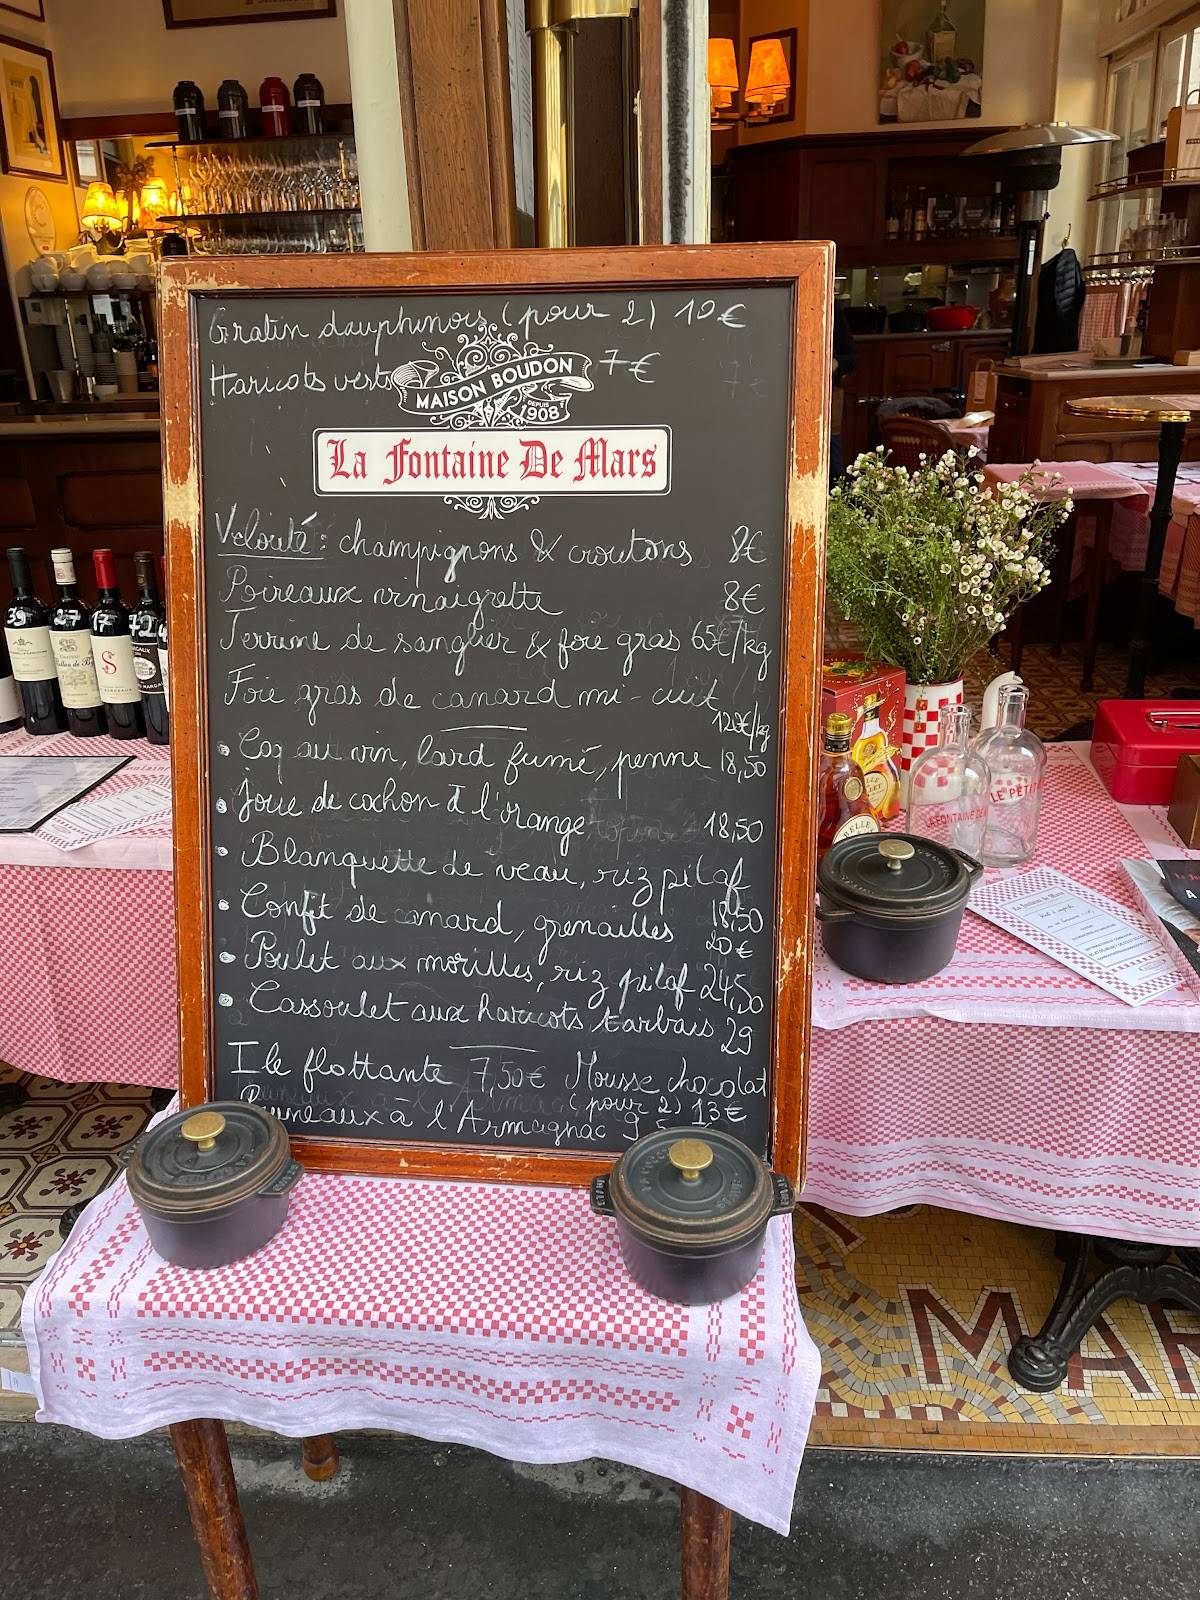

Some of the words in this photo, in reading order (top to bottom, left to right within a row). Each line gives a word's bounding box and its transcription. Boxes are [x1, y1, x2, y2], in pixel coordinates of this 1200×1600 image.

[209, 307, 309, 344] Gratin
[318, 306, 487, 356] dauphinois
[502, 301, 610, 340] (pour
[674, 299, 746, 328] 10€
[209, 361, 326, 398] Haricots
[334, 362, 394, 392] verts
[599, 349, 660, 383] 7€
[416, 380, 487, 409] MAISON
[490, 357, 573, 389] BOUDON
[521, 405, 559, 422] 1908
[527, 400, 550, 409] DEPUIS
[326, 438, 368, 480] La
[383, 437, 509, 486] Fontaine
[519, 439, 563, 481] De
[572, 437, 657, 484] Mars
[339, 518, 518, 588] champignons
[530, 528, 562, 562] &
[729, 525, 767, 563] 8€
[7, 606, 27, 627] 39
[54, 608, 81, 627] 27
[91, 610, 113, 634] 17
[220, 565, 362, 603] Poireaux
[374, 577, 563, 630] vinaigrette
[722, 580, 765, 614] 8€
[102, 650, 117, 675] S
[220, 607, 330, 650] Terrine
[340, 622, 386, 653] de
[394, 620, 518, 676] sanglier
[525, 631, 550, 659] &
[558, 628, 608, 670] foie
[616, 629, 681, 676] gras
[224, 663, 285, 705] Foie
[295, 684, 362, 726] gras
[374, 677, 421, 709] de
[432, 679, 572, 710] canard
[239, 726, 283, 784] Coq
[296, 740, 342, 760] au
[417, 735, 495, 767] lard
[611, 750, 712, 799] penne
[721, 748, 767, 783] 18,50
[311, 780, 342, 813] de
[349, 777, 440, 813] cochon
[703, 810, 764, 844] 18,50
[844, 820, 872, 838] BELLE
[241, 830, 436, 889] Blanquette
[442, 850, 483, 876] de
[592, 861, 653, 907] riz
[660, 855, 752, 916] pilaf
[712, 899, 764, 933] 18,50
[239, 882, 334, 936] Confit
[344, 895, 387, 923] de
[534, 905, 675, 966] grenailles
[244, 930, 340, 972] Poulet
[351, 954, 407, 971] aux
[550, 960, 609, 1009] riz
[619, 962, 696, 1014] pilaf
[700, 962, 764, 1015] 24,50
[249, 979, 409, 1022] Cassoulet
[411, 1002, 469, 1023] aux
[477, 992, 584, 1031] haricots
[591, 1004, 714, 1038] tarbais
[720, 1016, 753, 1056] 29
[227, 1041, 291, 1076] Ile
[303, 1046, 453, 1093] flottante
[565, 1050, 660, 1093] Mousse
[668, 1056, 767, 1098] chocolat
[389, 1097, 413, 1128] à
[570, 1093, 649, 1121] (pour
